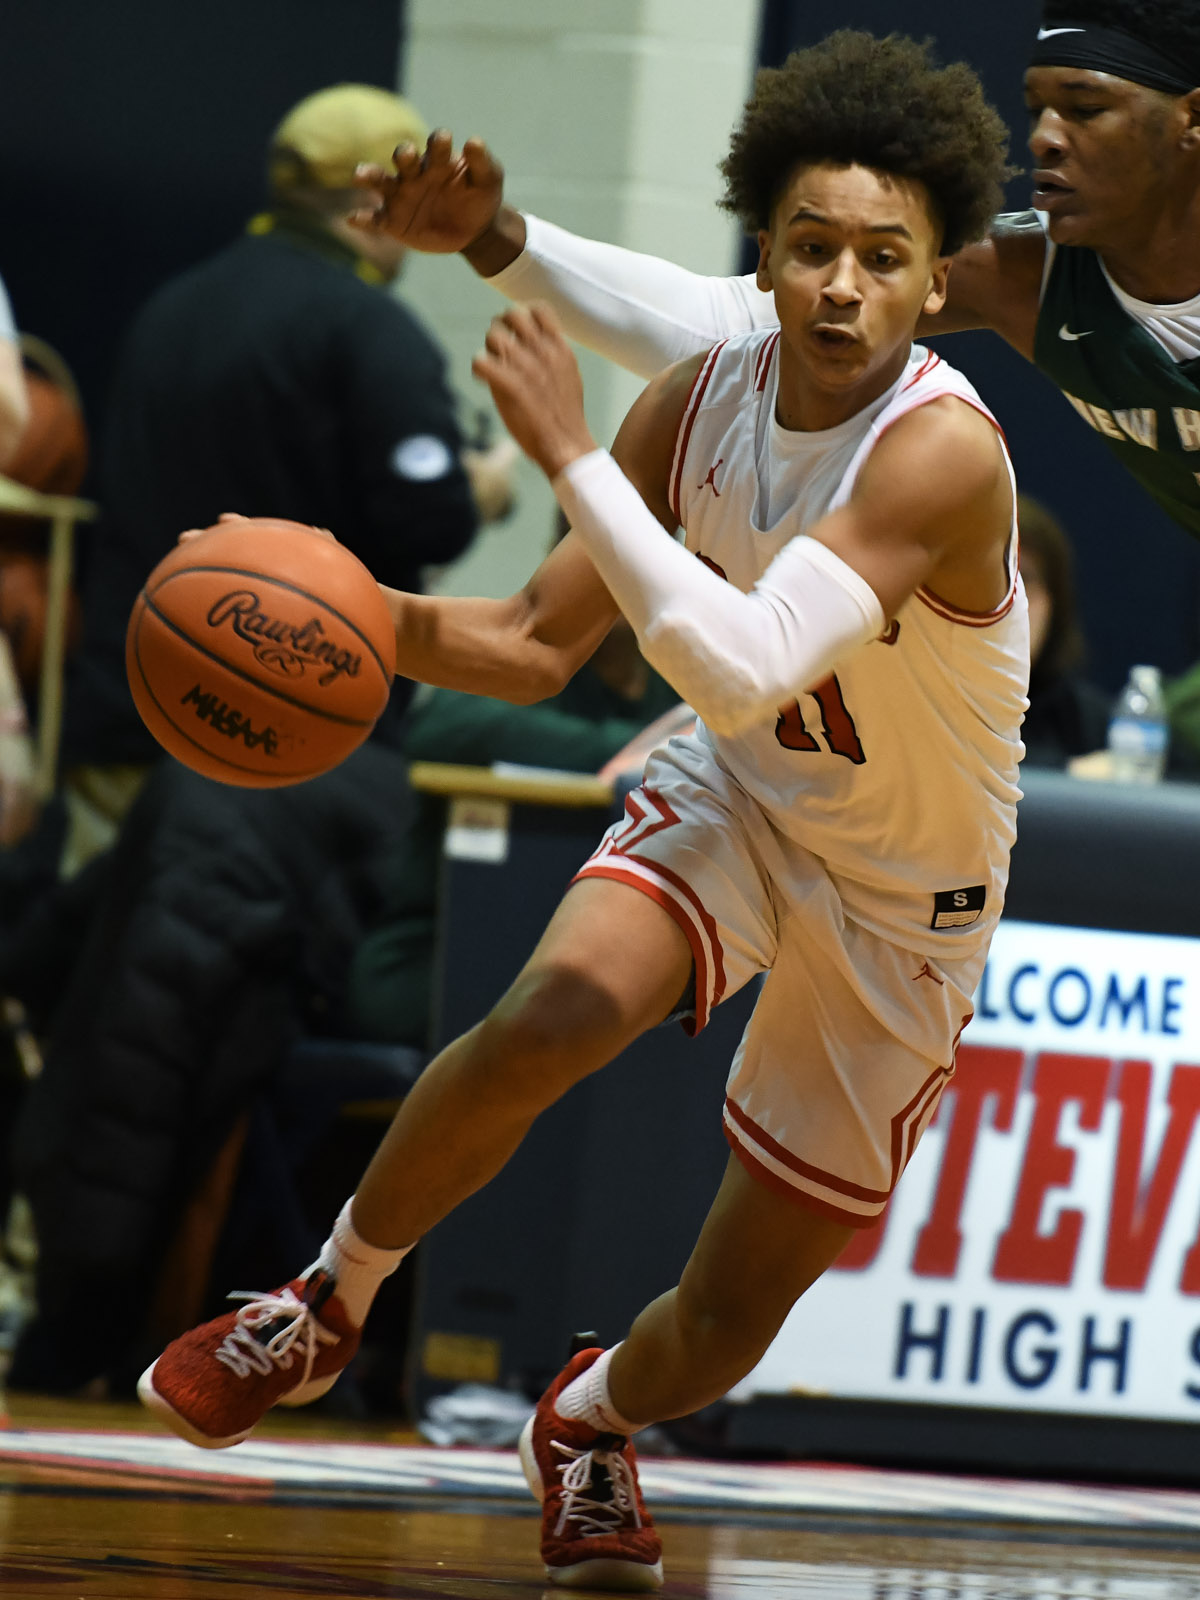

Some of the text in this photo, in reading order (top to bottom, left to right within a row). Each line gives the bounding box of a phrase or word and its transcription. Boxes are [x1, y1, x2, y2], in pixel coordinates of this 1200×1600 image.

[207, 590, 361, 687] Rawlings
[953, 892, 968, 907] S
[892, 1302, 1132, 1395] HIGH
